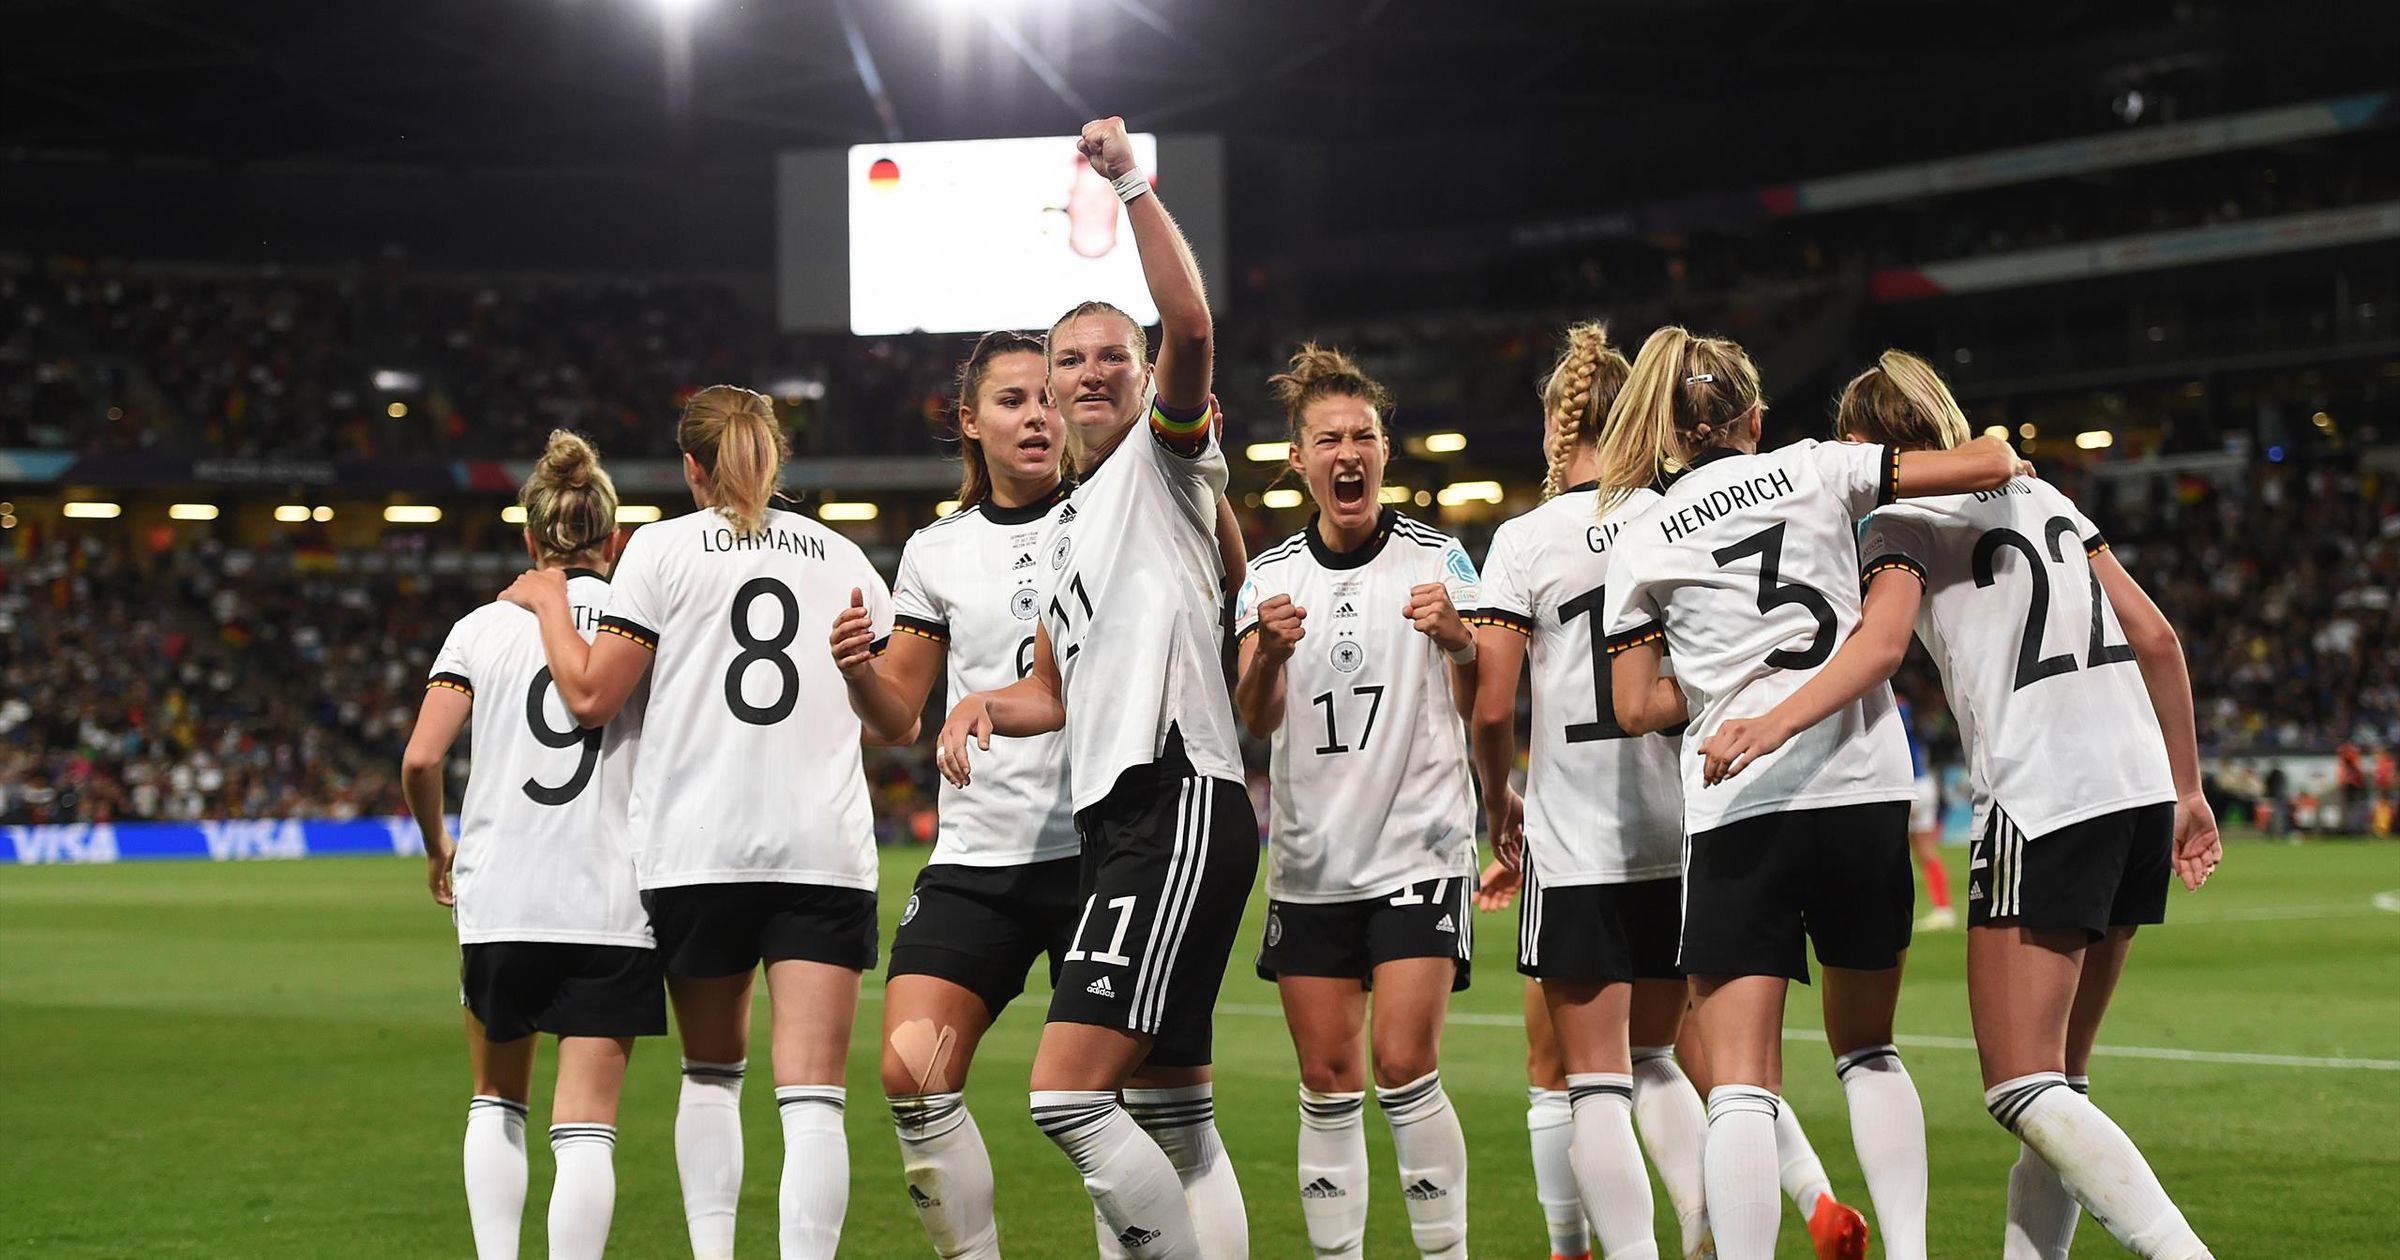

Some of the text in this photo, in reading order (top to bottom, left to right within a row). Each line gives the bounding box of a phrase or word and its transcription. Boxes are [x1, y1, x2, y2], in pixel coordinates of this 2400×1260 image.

[1660, 468, 1794, 543] HENDRICH
[702, 528, 826, 561] LOHMANN
[1711, 520, 1838, 670] 3
[1972, 516, 2137, 692] 22
[724, 577, 800, 726] 8
[521, 664, 601, 806] 9
[1313, 685, 1385, 755] 17
[8, 824, 119, 863] VISA
[202, 820, 308, 859] VISA
[1064, 893, 1137, 967] 11
[1086, 985, 1116, 998] adidas
